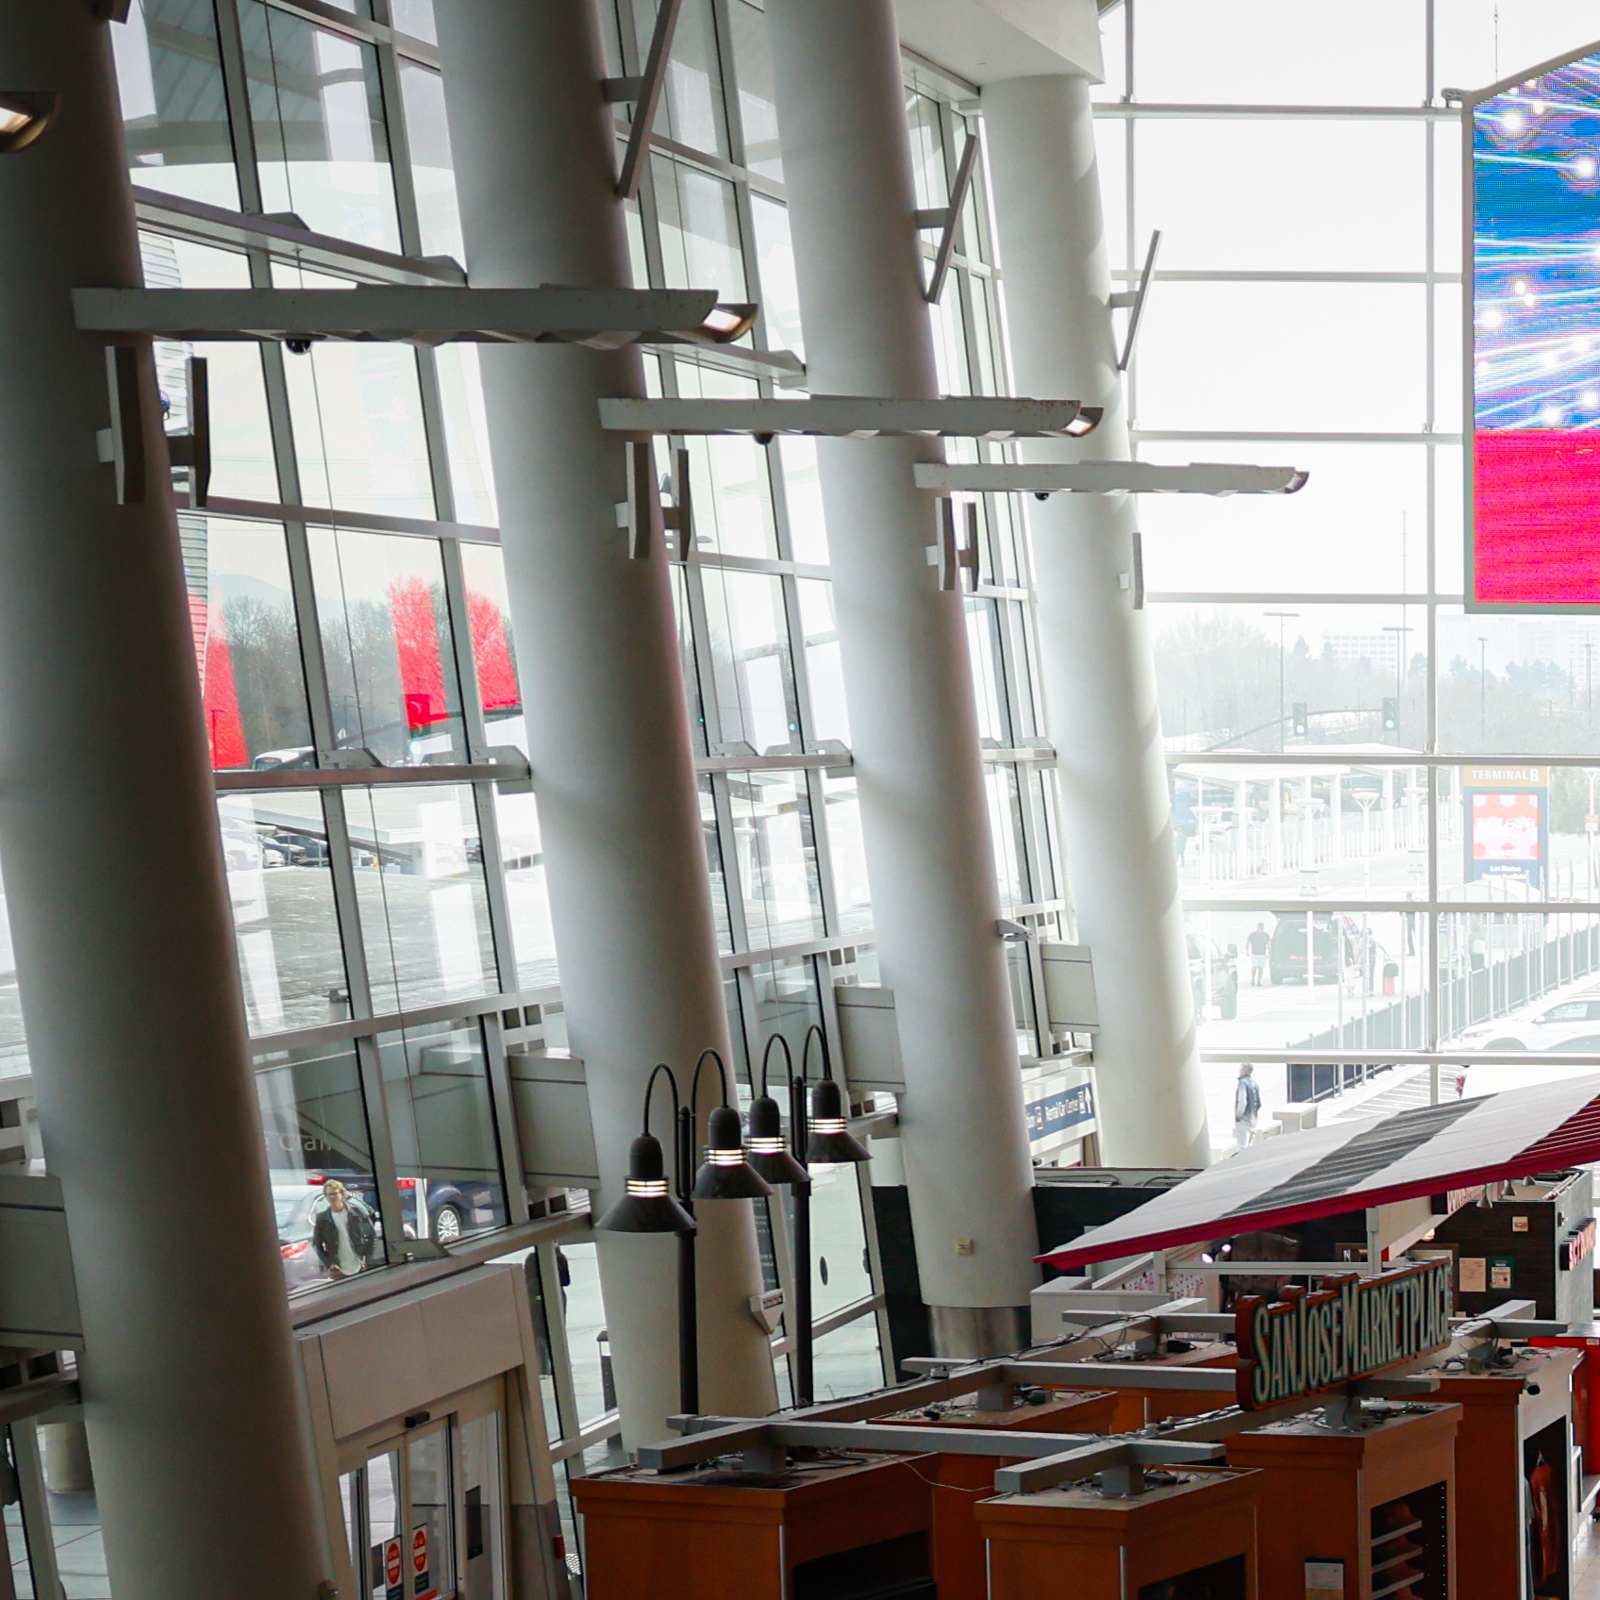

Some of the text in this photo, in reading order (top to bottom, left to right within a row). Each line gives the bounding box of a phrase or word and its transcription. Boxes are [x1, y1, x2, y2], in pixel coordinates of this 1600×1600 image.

[1472, 768, 1540, 782] TERMINAL B
[279, 1132, 332, 1152] Clai
[1254, 1262, 1453, 1404] SAN JOSE MARKETPLACE
